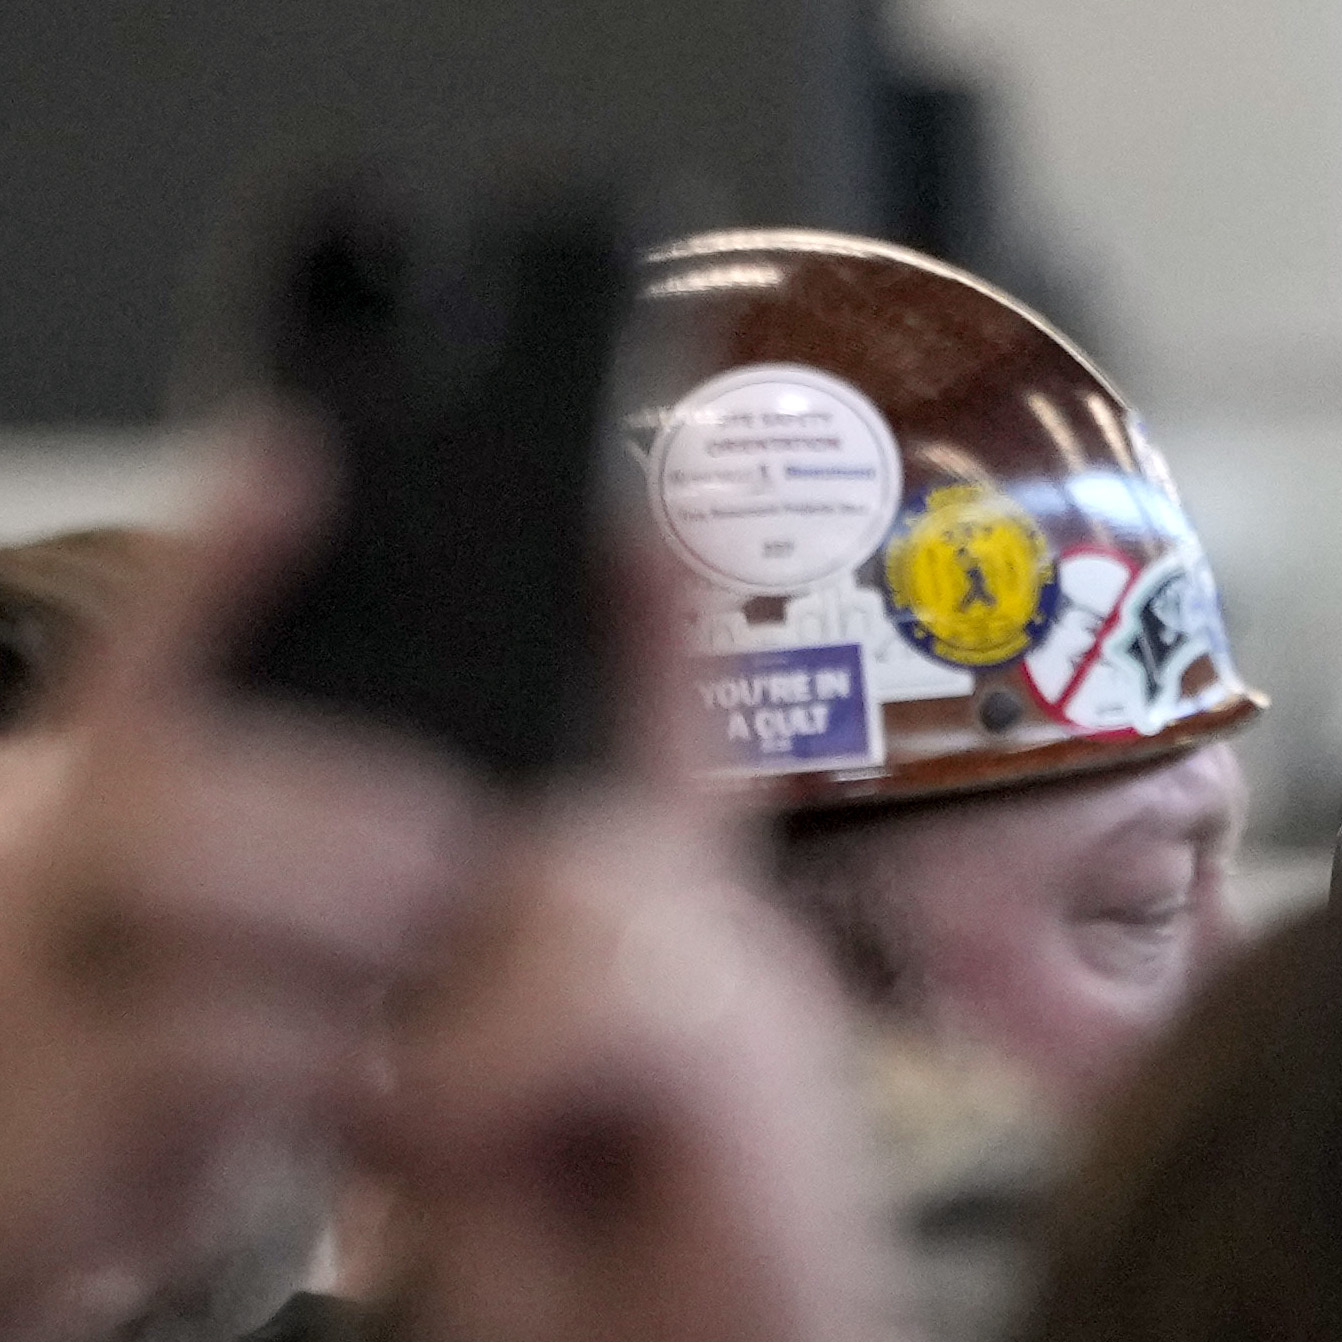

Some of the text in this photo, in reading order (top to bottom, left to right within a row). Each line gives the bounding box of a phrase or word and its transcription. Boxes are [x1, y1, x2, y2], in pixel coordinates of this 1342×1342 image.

[698, 668, 851, 709] YOU'RE IN
[727, 704, 829, 741] A CULT
